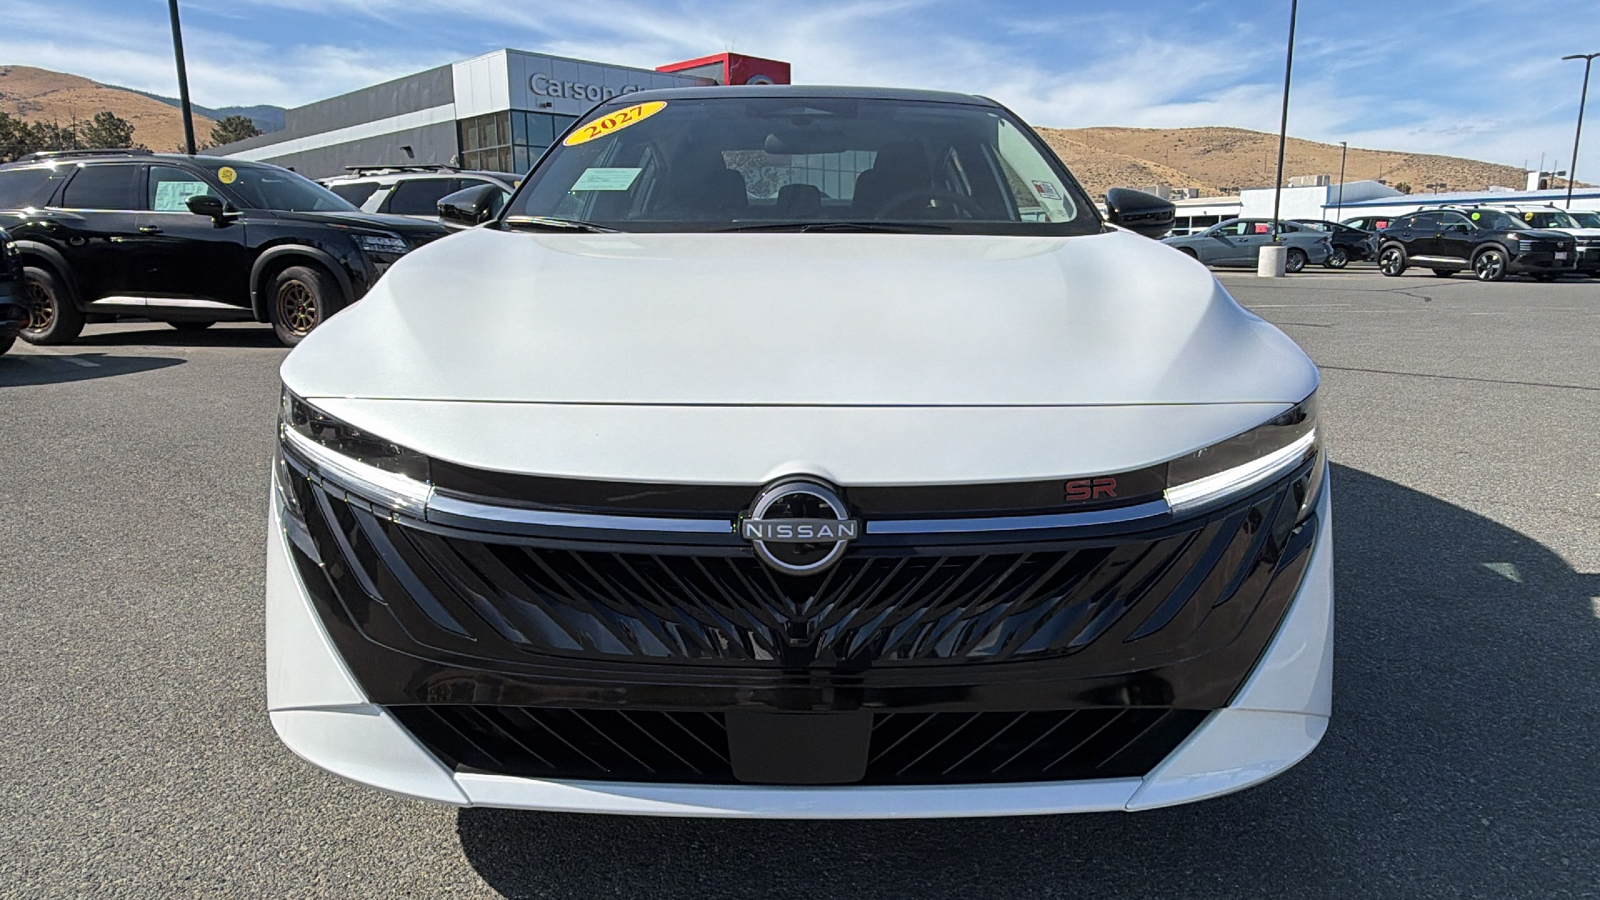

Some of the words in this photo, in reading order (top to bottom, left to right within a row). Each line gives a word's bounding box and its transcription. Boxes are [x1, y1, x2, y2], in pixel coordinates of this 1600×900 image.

[530, 73, 615, 101] Carson
[584, 106, 642, 138] 2027
[1065, 477, 1117, 501] SR
[745, 522, 855, 539] NISSAN
